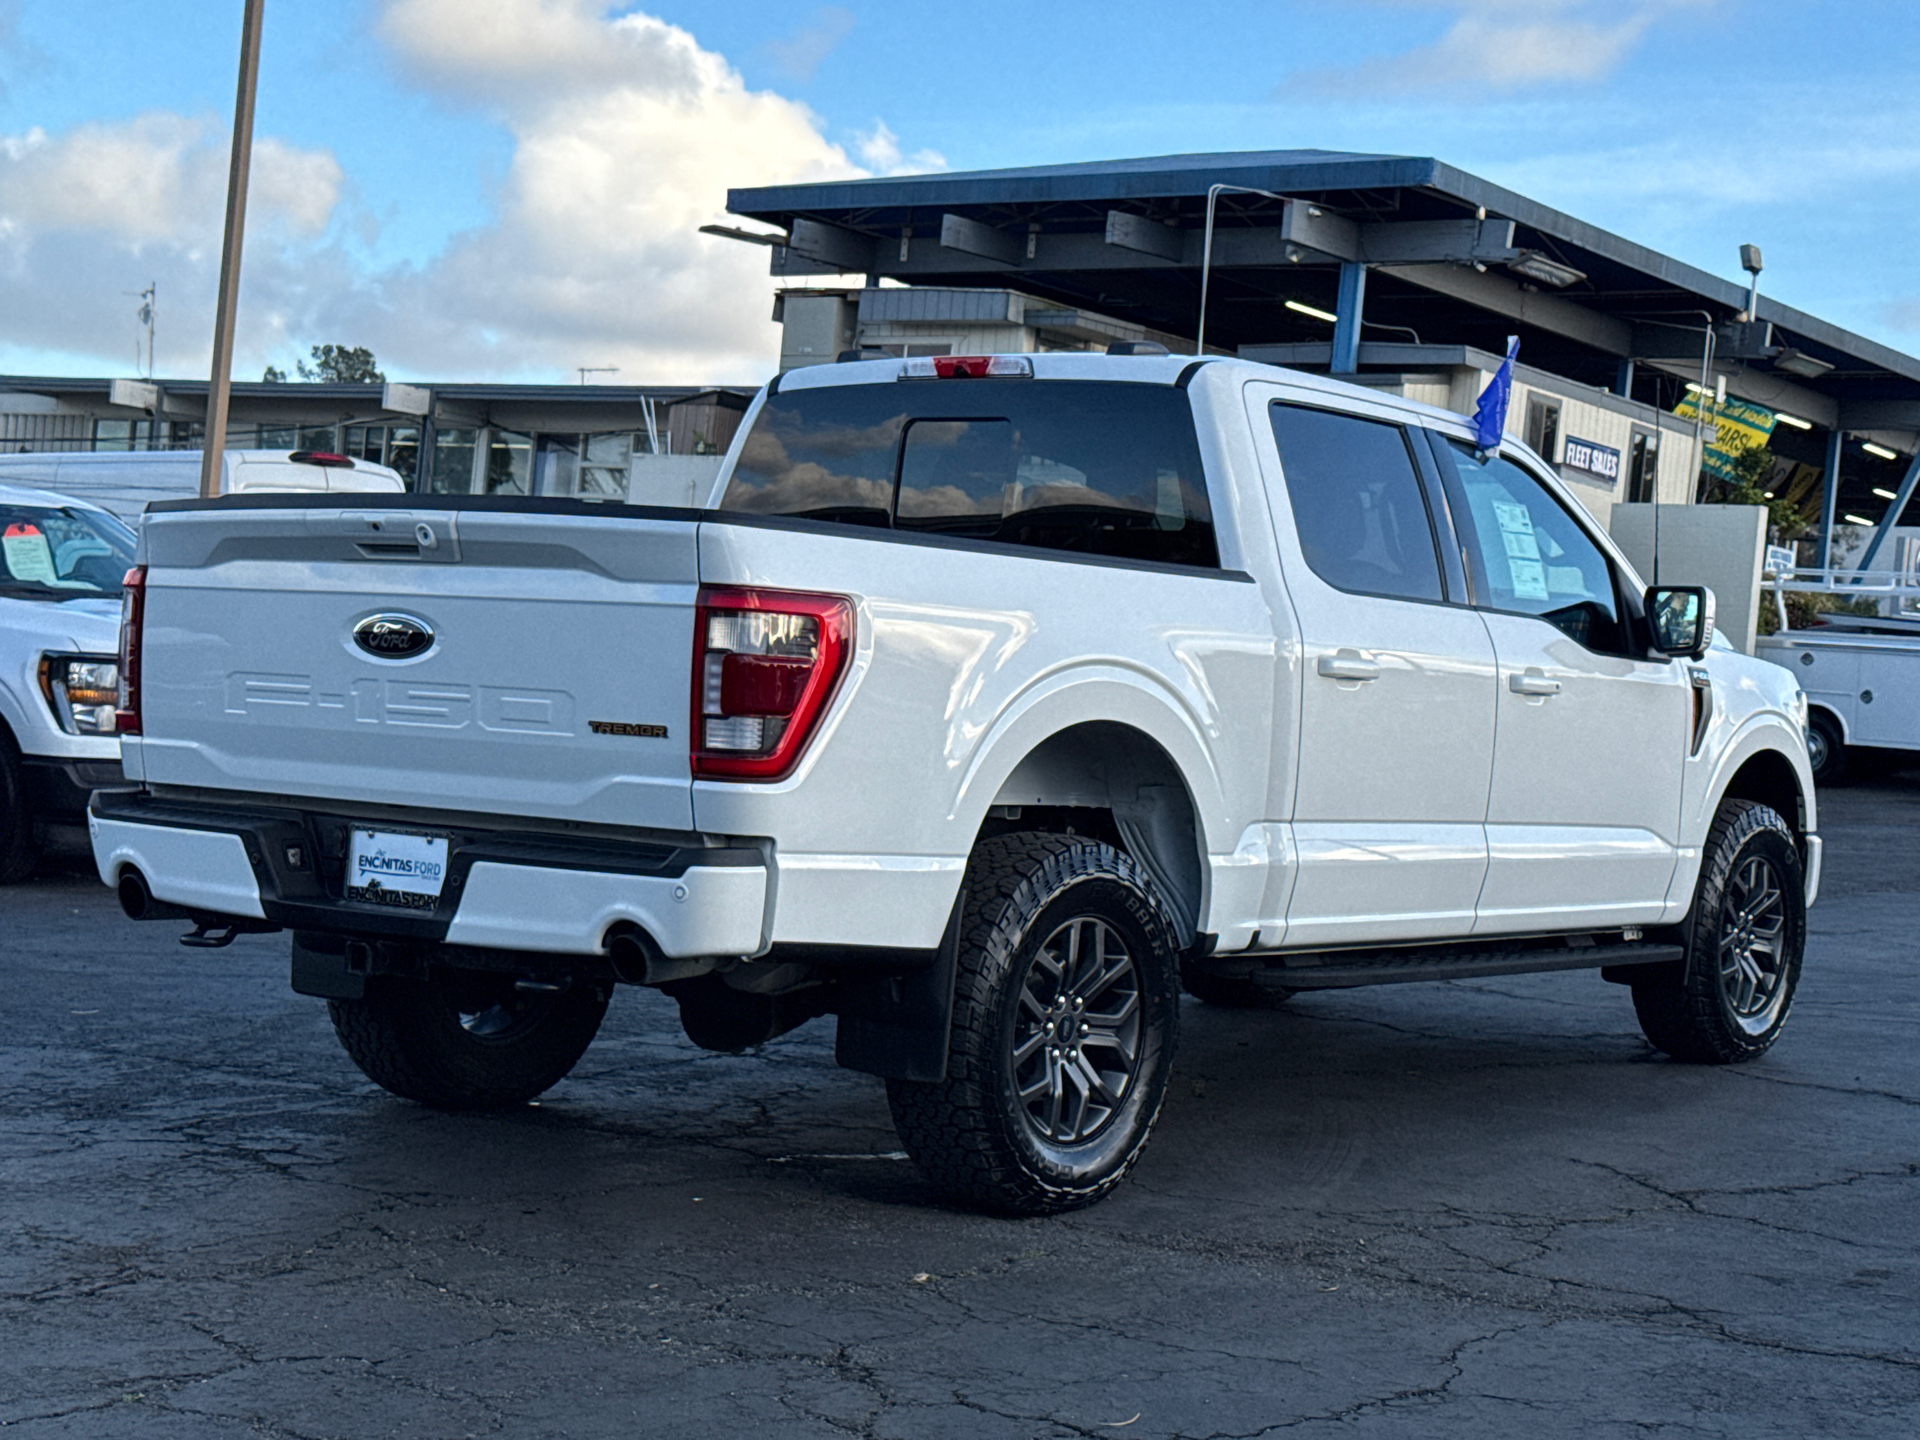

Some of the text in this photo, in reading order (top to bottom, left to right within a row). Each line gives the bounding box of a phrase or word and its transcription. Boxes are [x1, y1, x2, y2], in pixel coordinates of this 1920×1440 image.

[1566, 442, 1618, 477] FLEET SALES
[369, 621, 412, 649] Ford
[225, 670, 576, 737] F-150
[588, 720, 669, 739] TREMOR
[358, 853, 441, 876] ENCINITAS FORD
